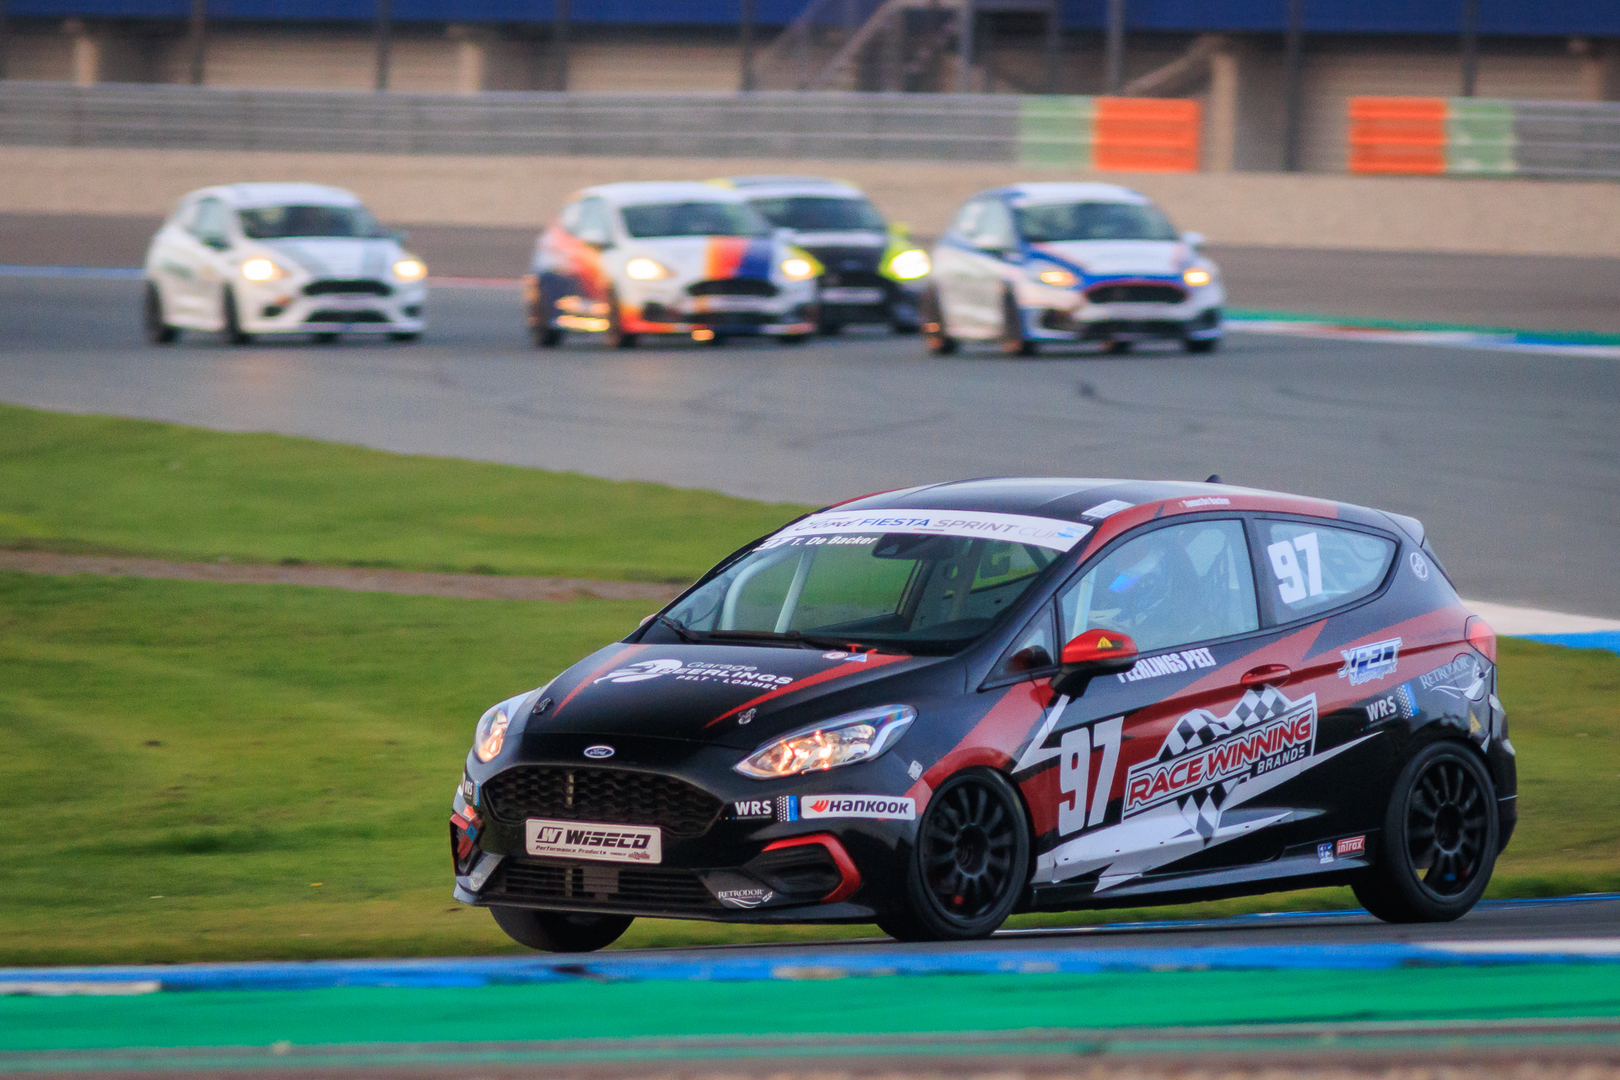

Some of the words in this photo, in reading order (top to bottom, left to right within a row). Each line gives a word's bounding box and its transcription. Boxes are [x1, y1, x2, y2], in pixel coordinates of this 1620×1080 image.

[858, 518, 931, 527] FIESTA
[933, 519, 1020, 533] SPRINT
[805, 537, 827, 546] De
[827, 536, 878, 545] Backer
[1268, 532, 1322, 604] 97
[687, 661, 757, 671] Garage
[1180, 647, 1217, 671] PELT
[1419, 656, 1470, 690] RETRODOR
[723, 679, 778, 690] LOMMEL
[1366, 696, 1397, 722] WRS
[1257, 747, 1306, 775] BRANDS
[1058, 716, 1124, 837] 97
[735, 800, 772, 815] WRS
[535, 845, 577, 853] Performance
[718, 888, 763, 899] RETRODOR
